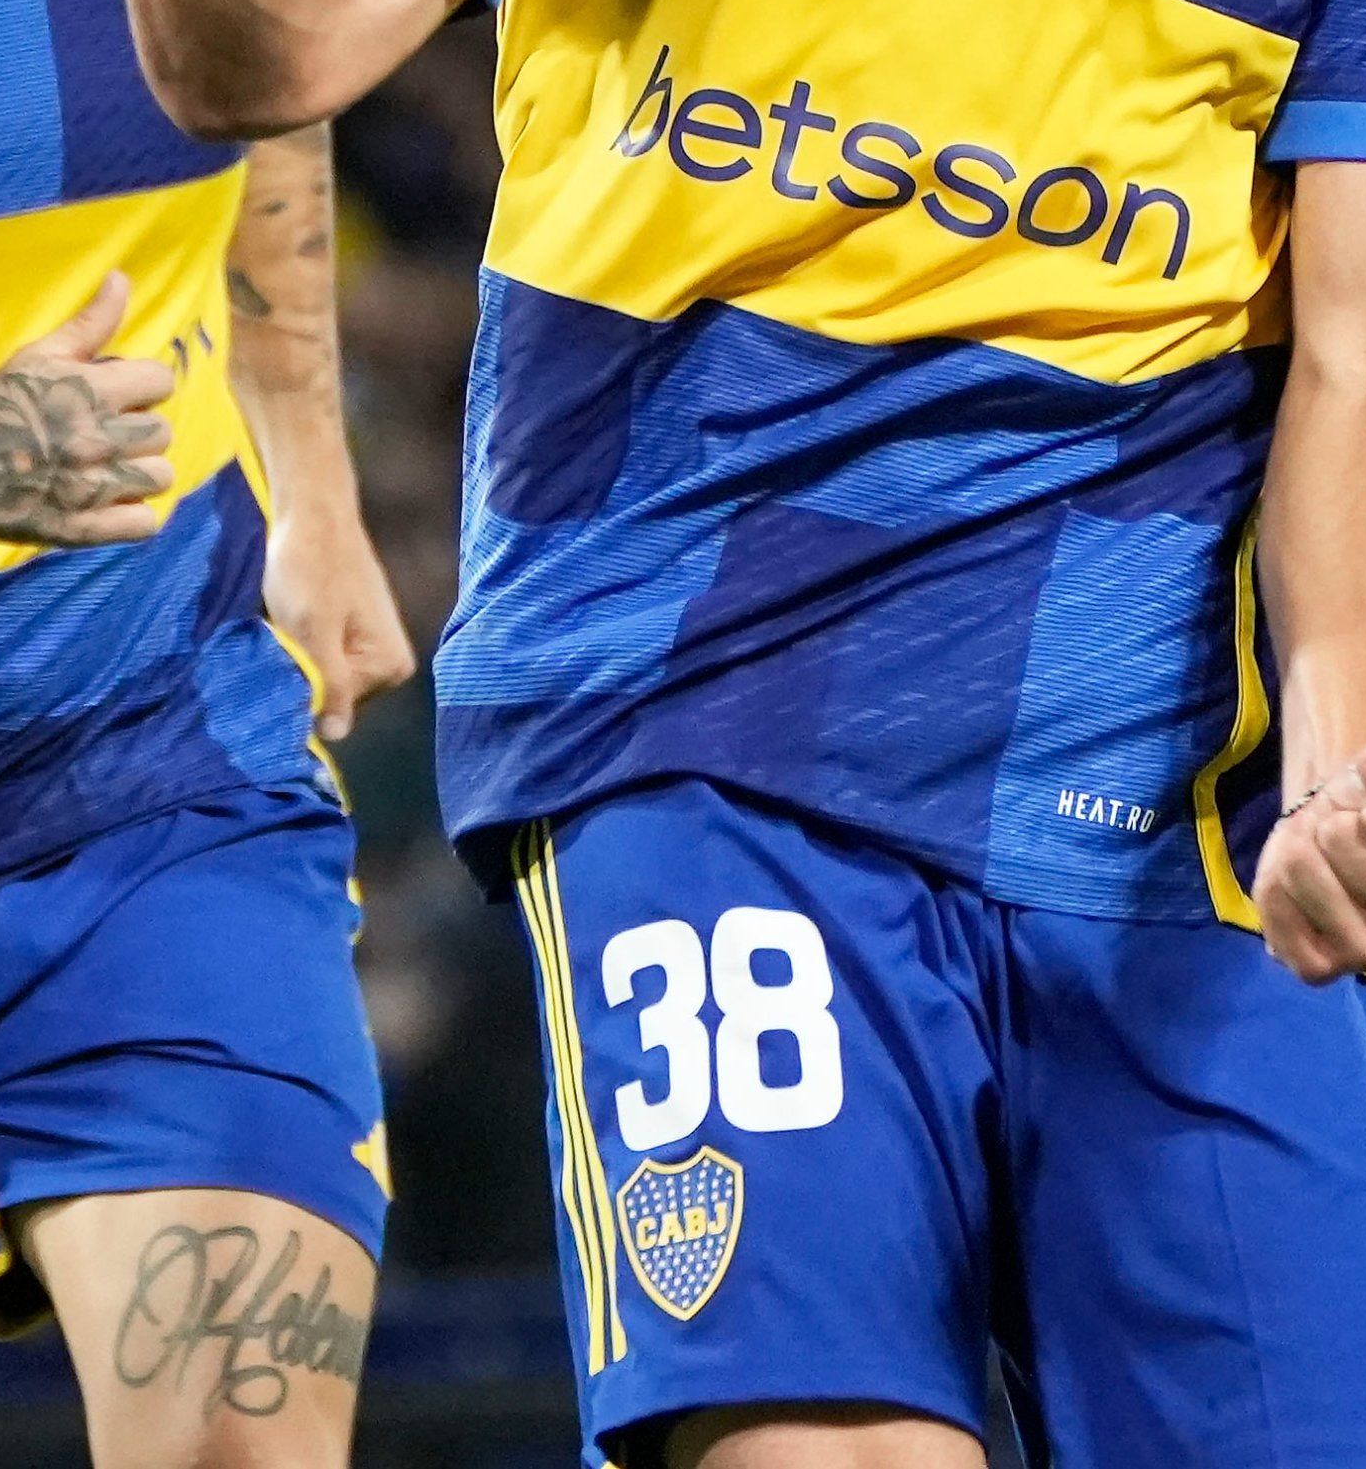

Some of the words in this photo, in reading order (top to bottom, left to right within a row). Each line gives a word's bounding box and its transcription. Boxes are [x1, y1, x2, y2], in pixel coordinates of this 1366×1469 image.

[610, 44, 1192, 280] betsson
[601, 906, 844, 1151] 38
[636, 1201, 728, 1251] CABJ
